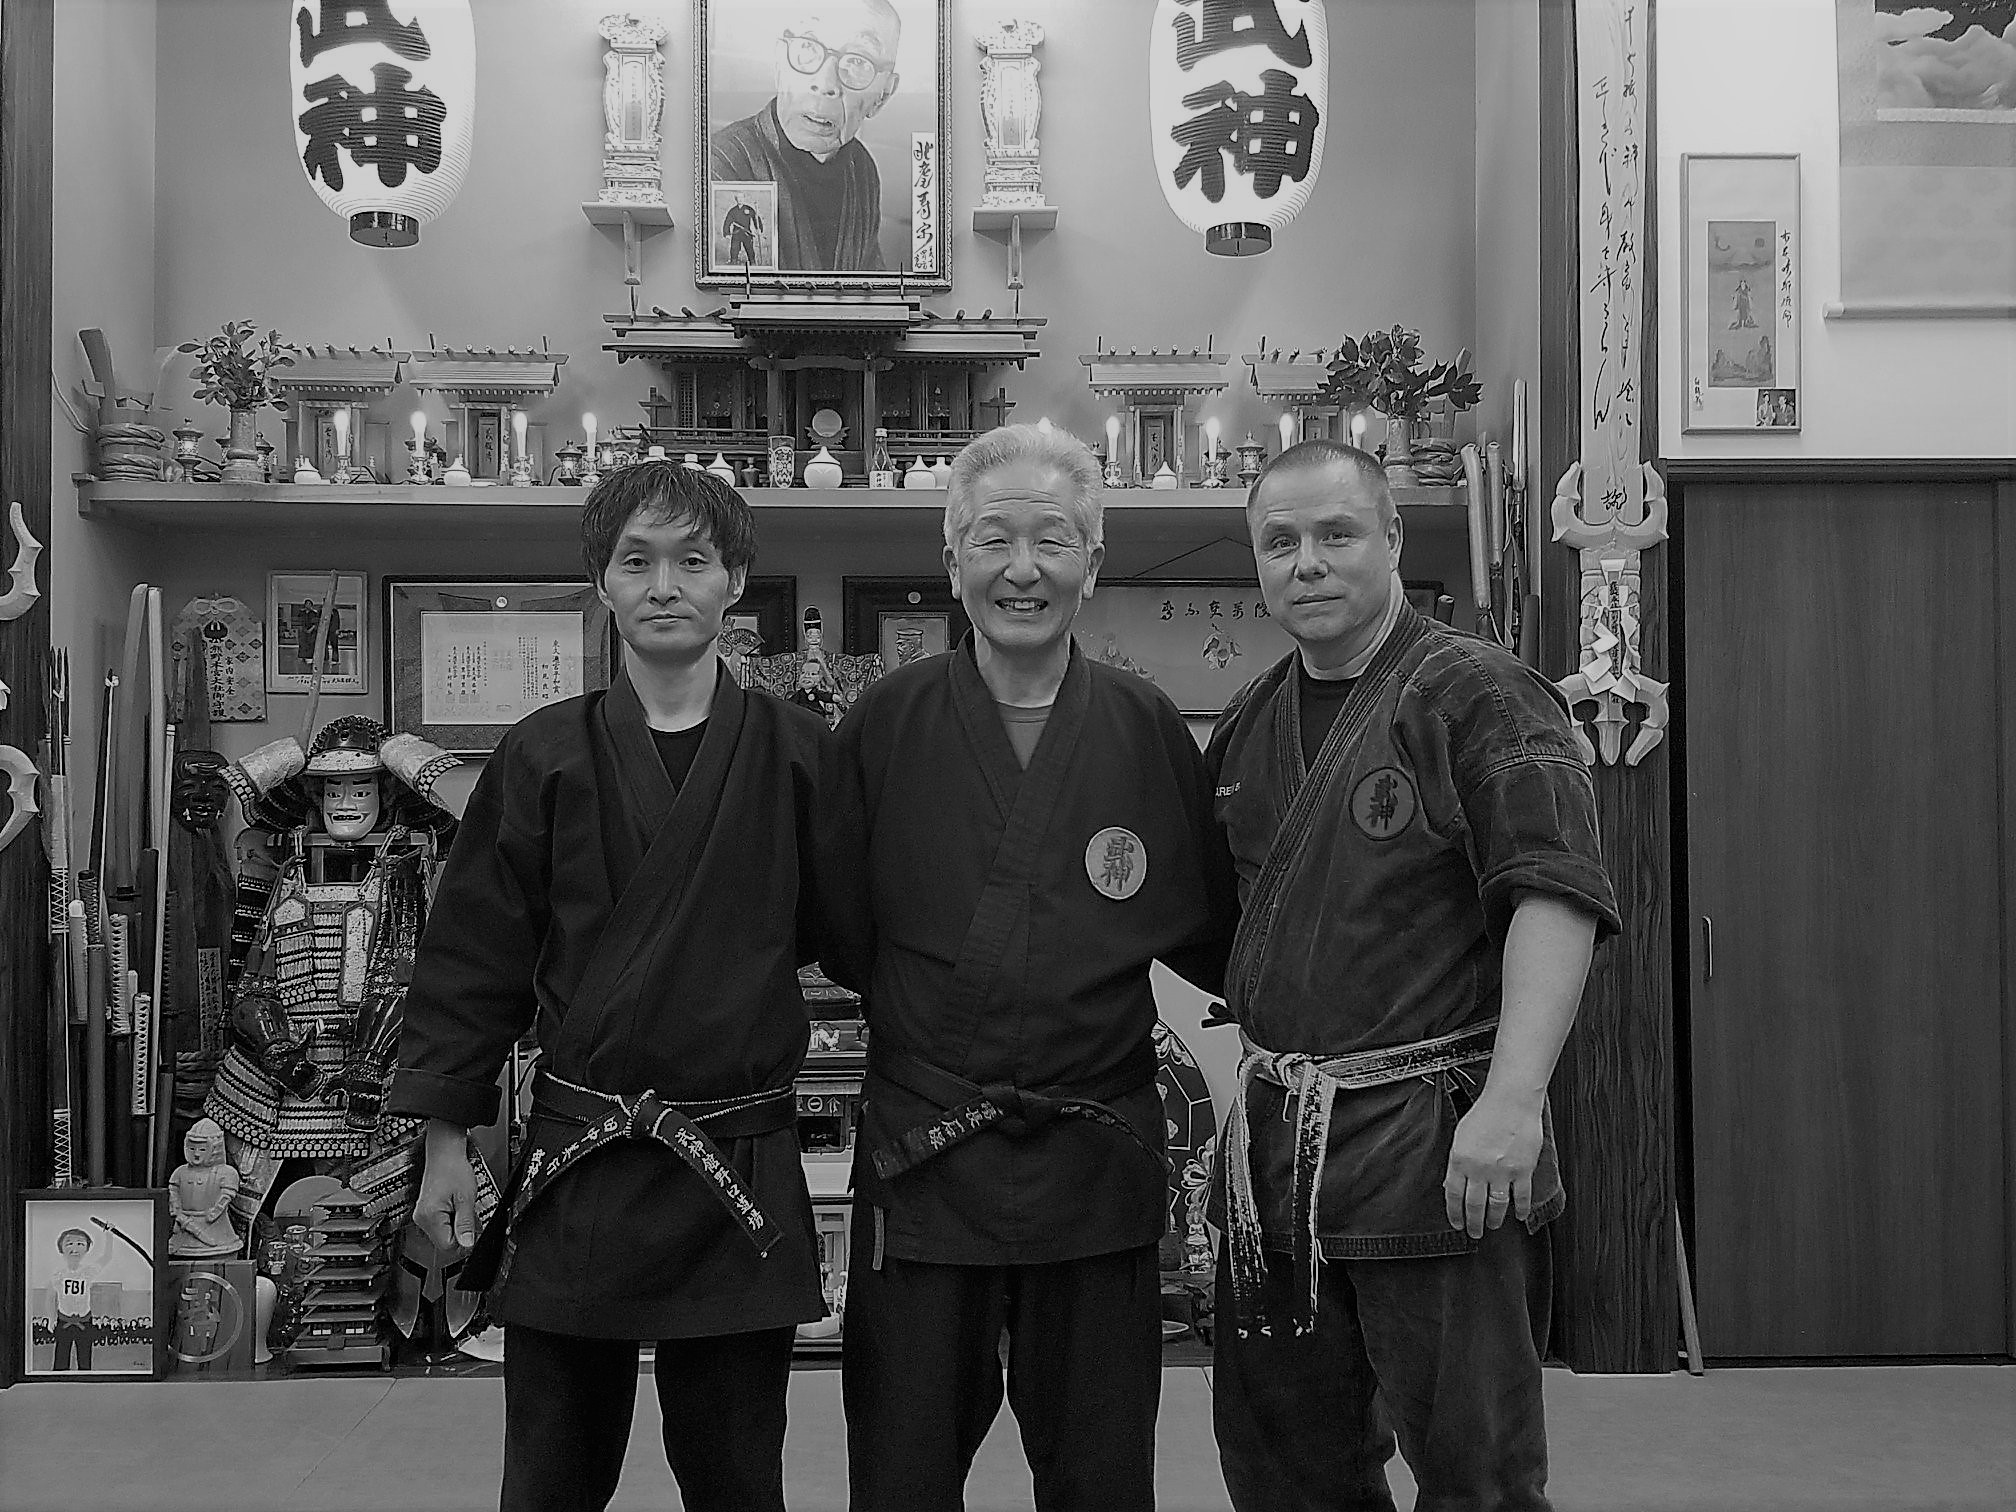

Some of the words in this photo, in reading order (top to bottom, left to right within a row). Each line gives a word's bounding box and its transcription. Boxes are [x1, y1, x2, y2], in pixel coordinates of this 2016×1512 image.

[674, 1126, 765, 1231] 武神館野口道場
[64, 1279, 85, 1295] FBI
